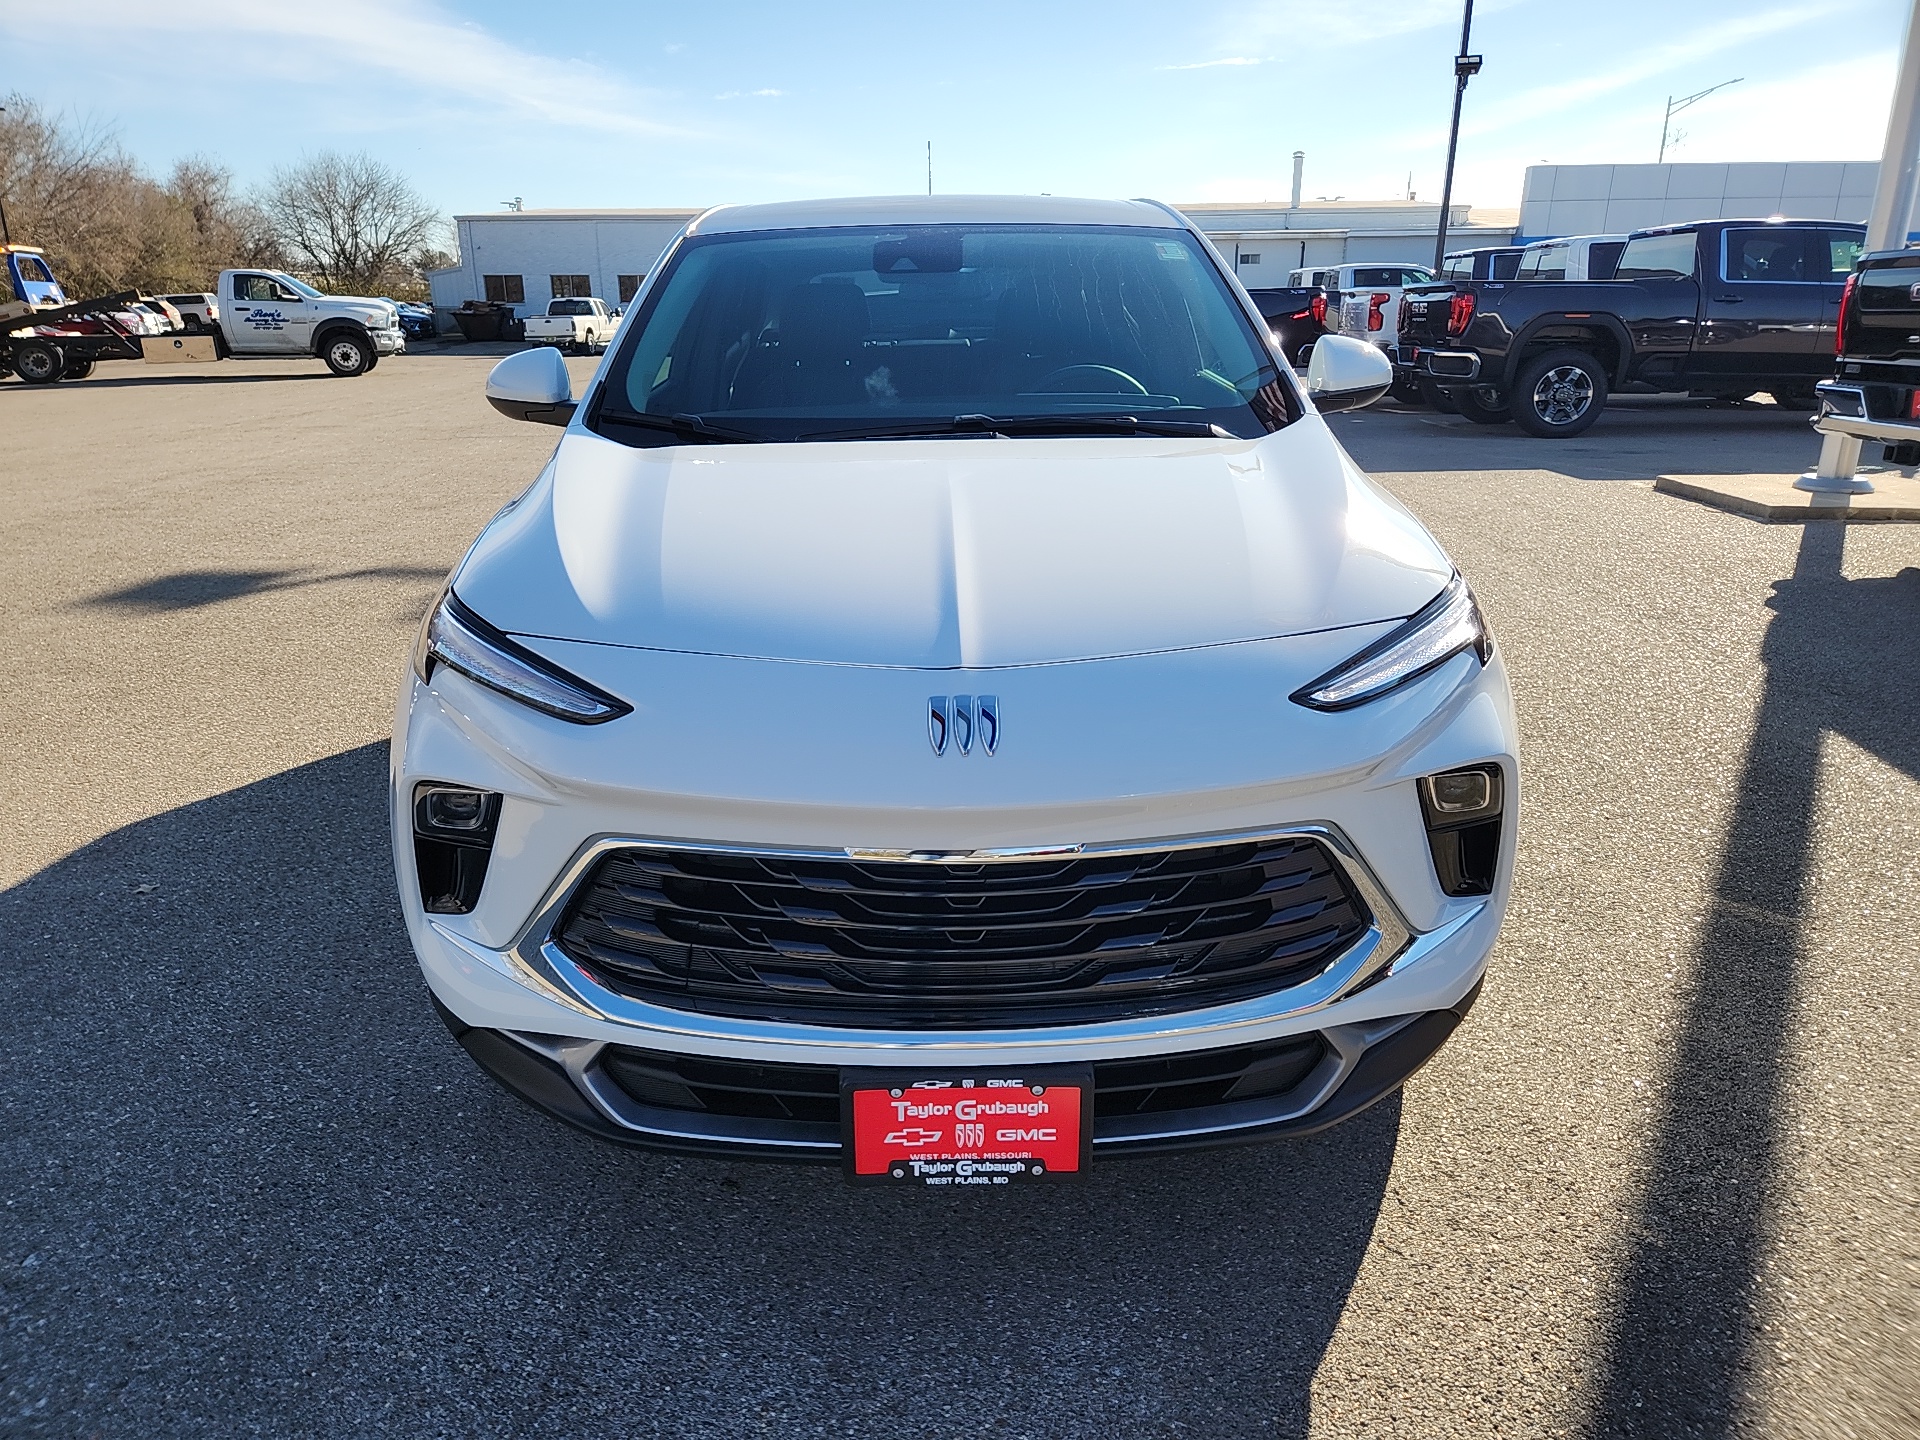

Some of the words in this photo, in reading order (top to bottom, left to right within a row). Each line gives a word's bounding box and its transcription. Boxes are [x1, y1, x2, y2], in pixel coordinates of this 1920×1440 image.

[987, 1079, 1024, 1088] GMC
[891, 1101, 952, 1121] Taylor
[955, 1100, 1049, 1120] Grubaugh
[996, 1128, 1057, 1141] GMC
[983, 1151, 1032, 1159] MISSOURI
[908, 1161, 955, 1176] Taylor
[956, 1160, 1026, 1175] Grubaugh
[925, 1177, 953, 1185] WEST
[993, 1176, 1009, 1184] MO
